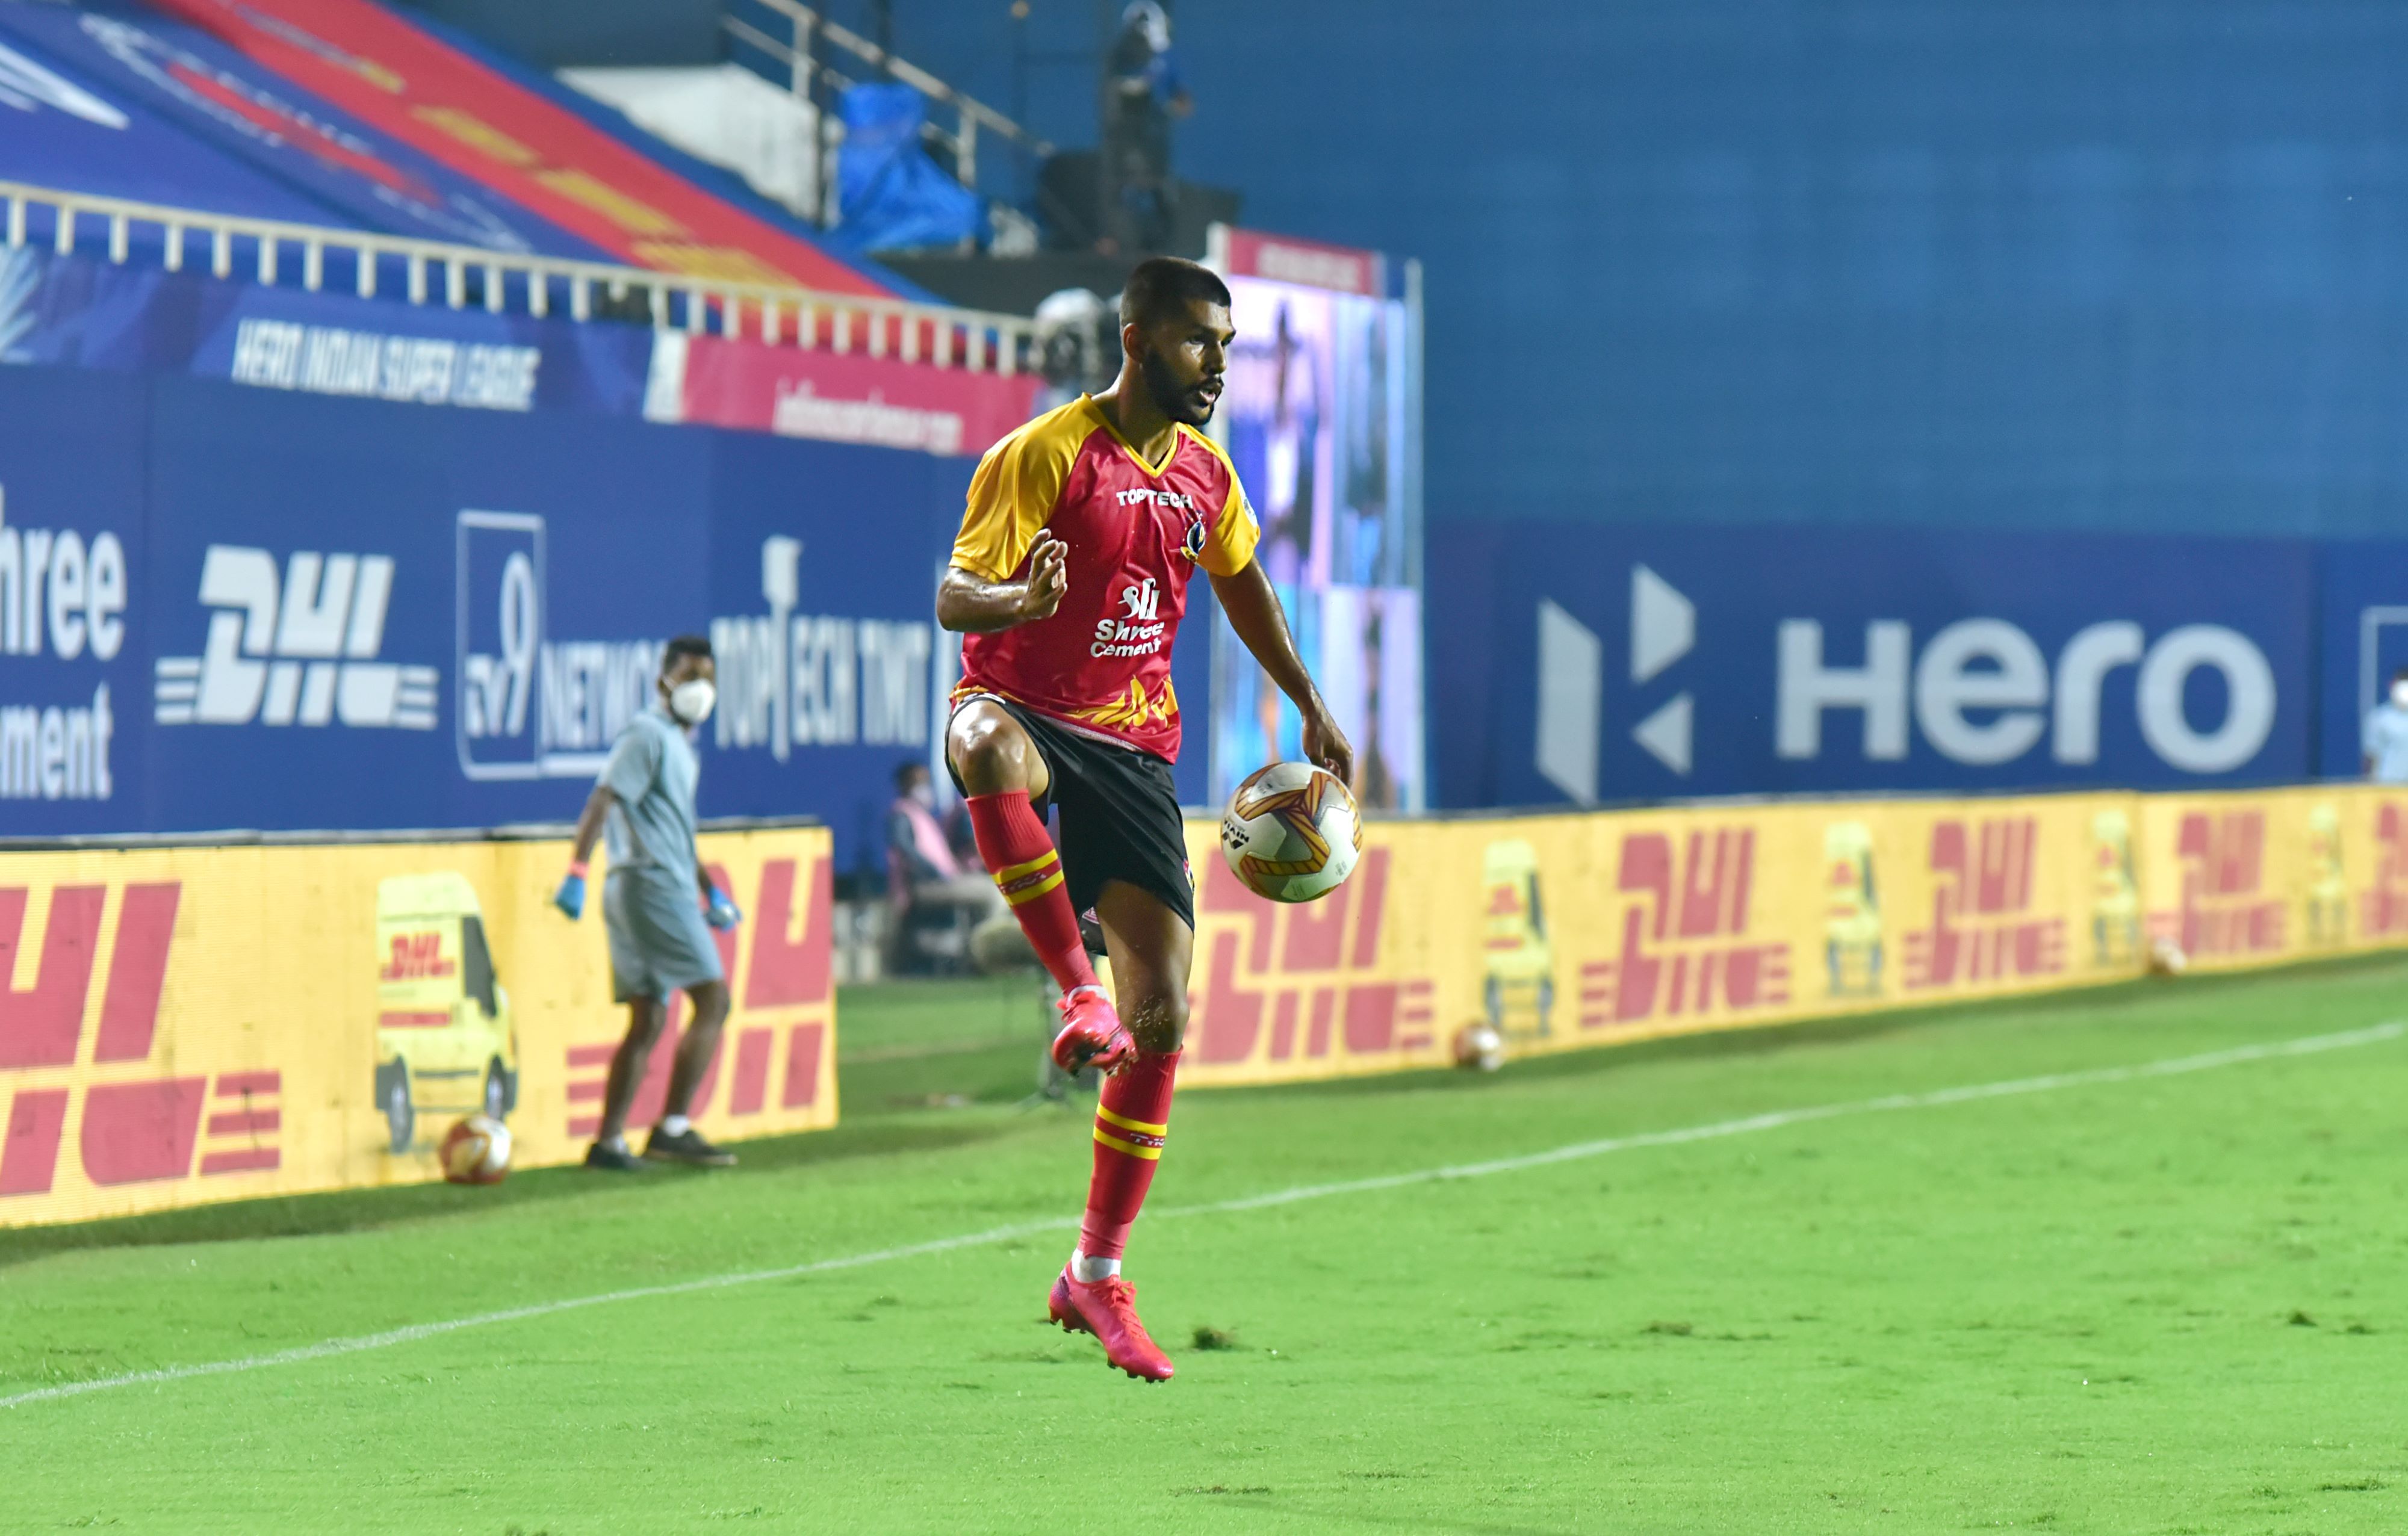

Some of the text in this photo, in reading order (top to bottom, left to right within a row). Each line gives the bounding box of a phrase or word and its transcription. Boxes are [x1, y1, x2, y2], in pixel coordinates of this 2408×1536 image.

[1116, 488, 1194, 509] TOPTECH
[197, 544, 401, 726] DHL
[539, 639, 667, 748] NETWO
[1090, 637, 1162, 658] Cement
[1094, 619, 1165, 642] Shree
[1776, 616, 2278, 775] Hero
[1198, 845, 1400, 1067] DHL
[1614, 828, 1763, 1023] DHL
